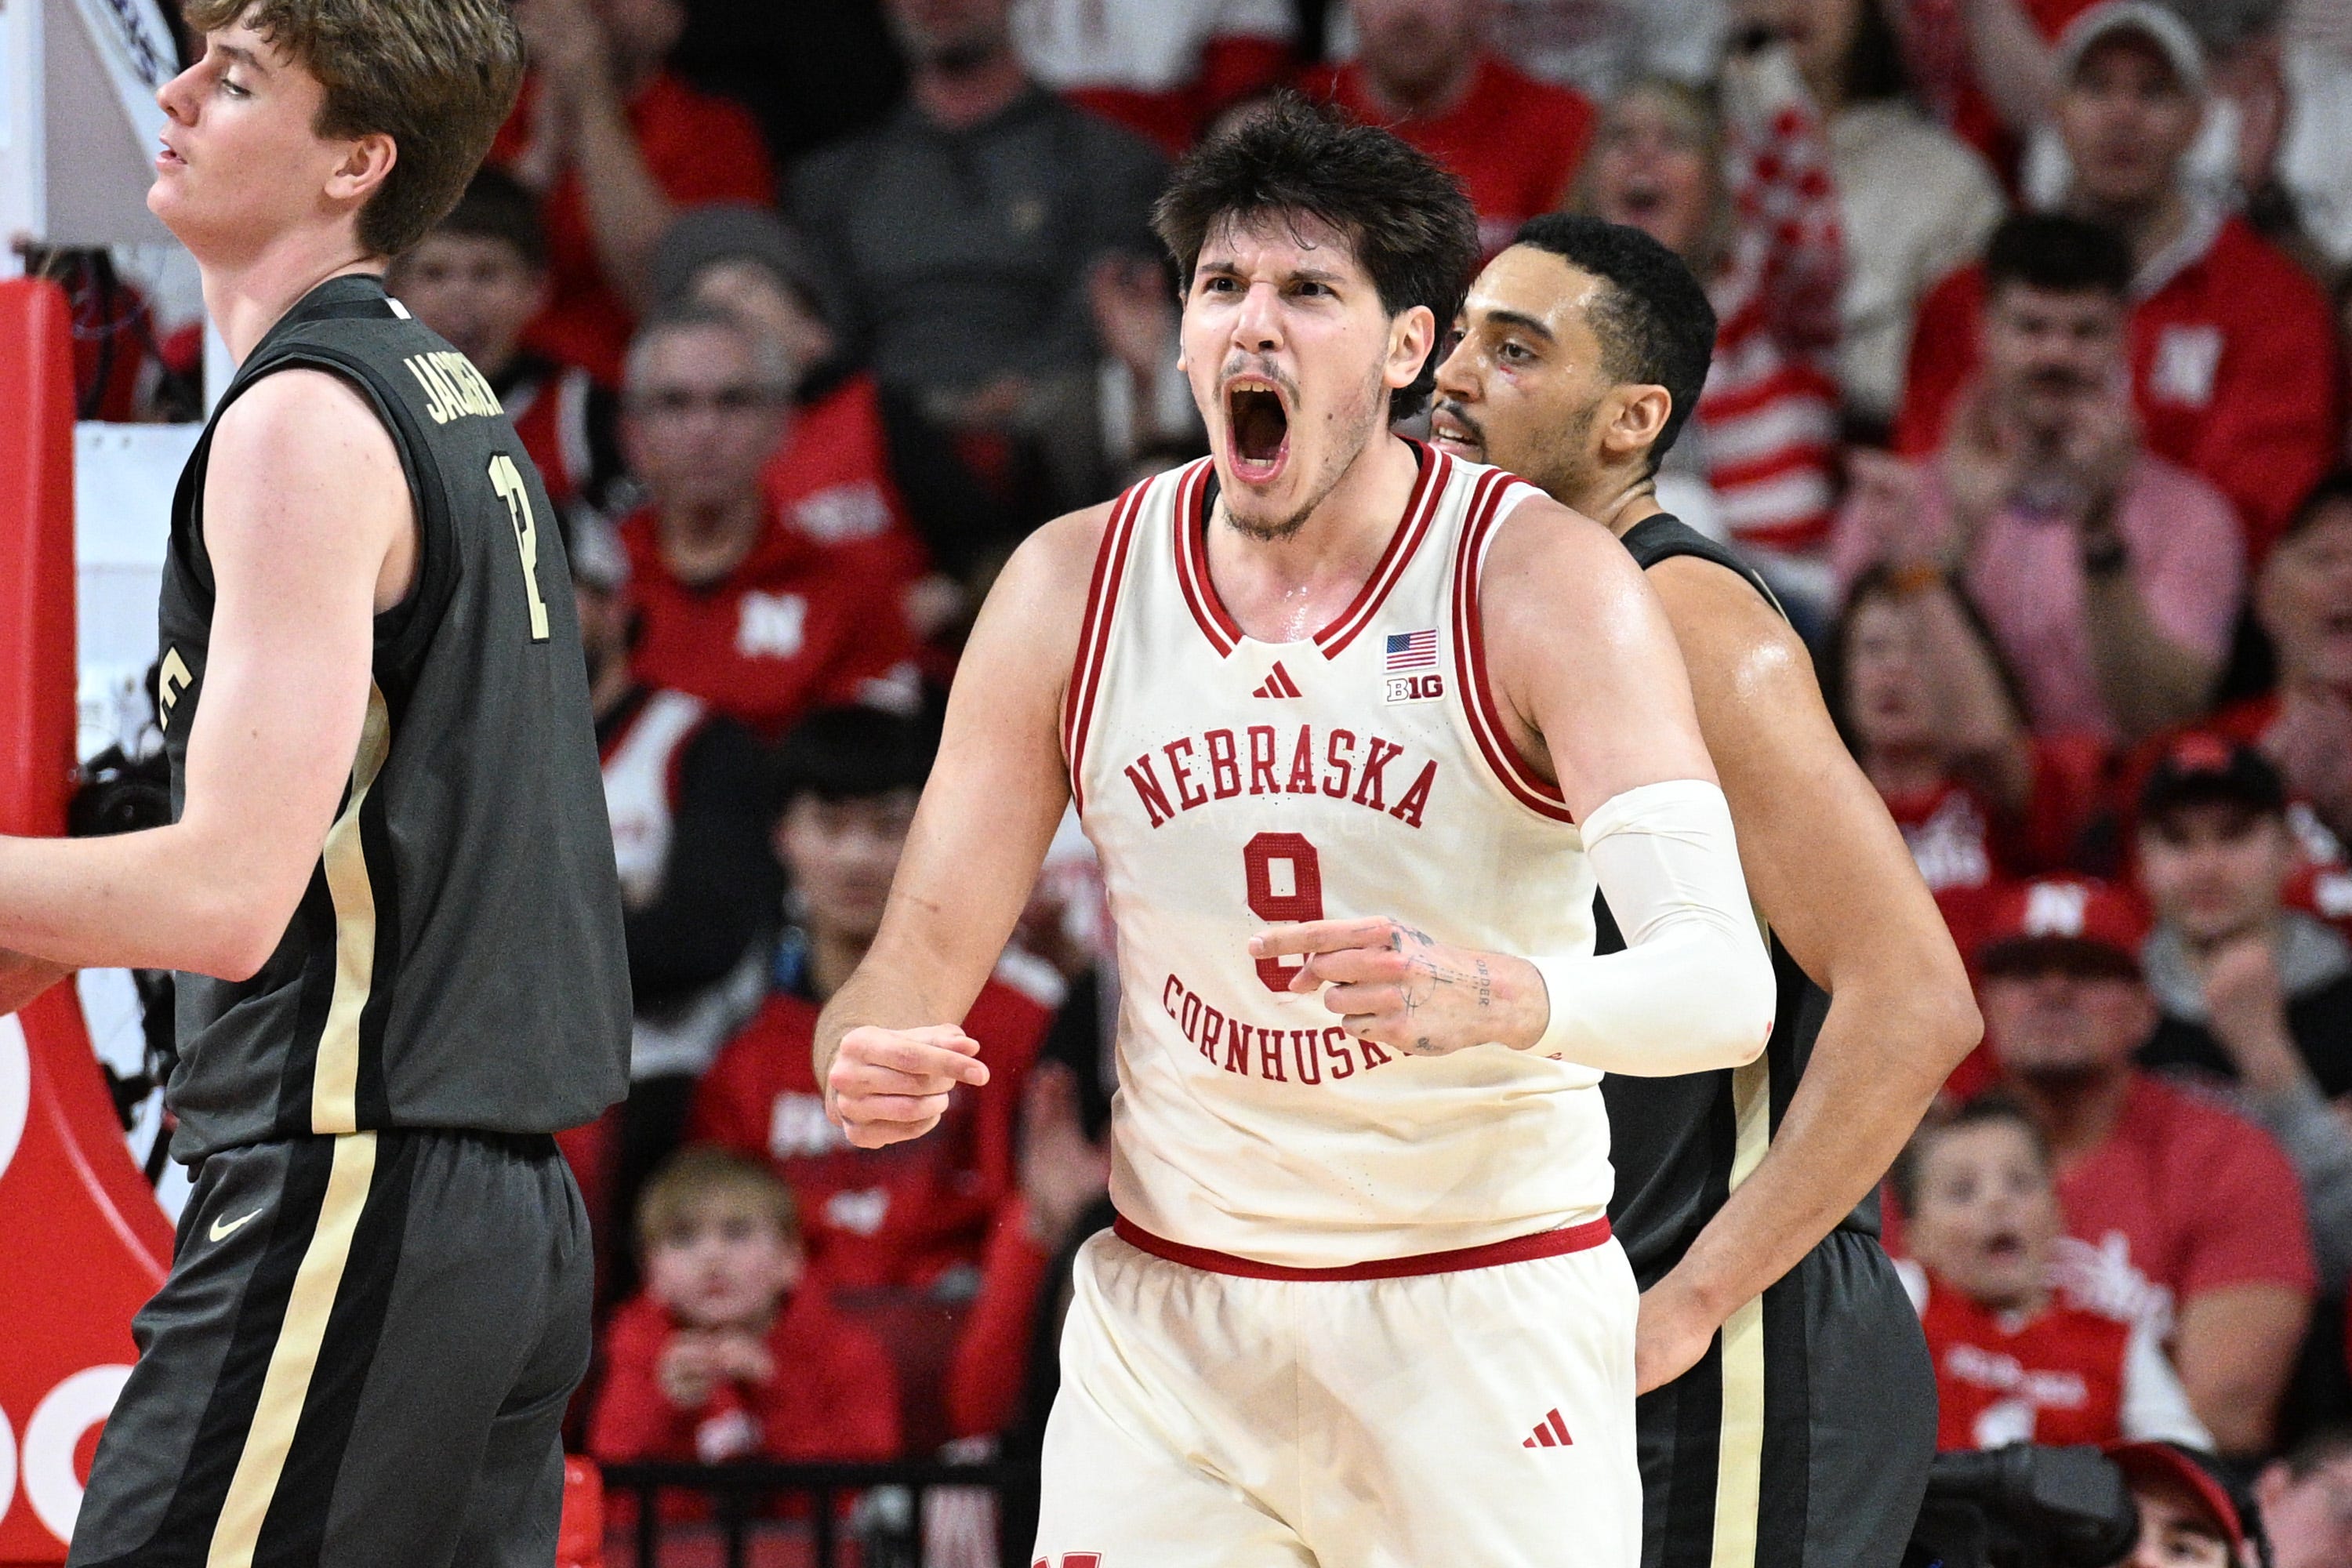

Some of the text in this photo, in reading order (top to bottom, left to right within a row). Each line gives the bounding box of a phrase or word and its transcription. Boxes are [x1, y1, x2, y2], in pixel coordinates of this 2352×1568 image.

[488, 452, 550, 641] 2
[1123, 724, 1438, 829] NEBRASKA
[1243, 832, 1324, 993] 9
[1163, 973, 1413, 1085] CORNHUSK
